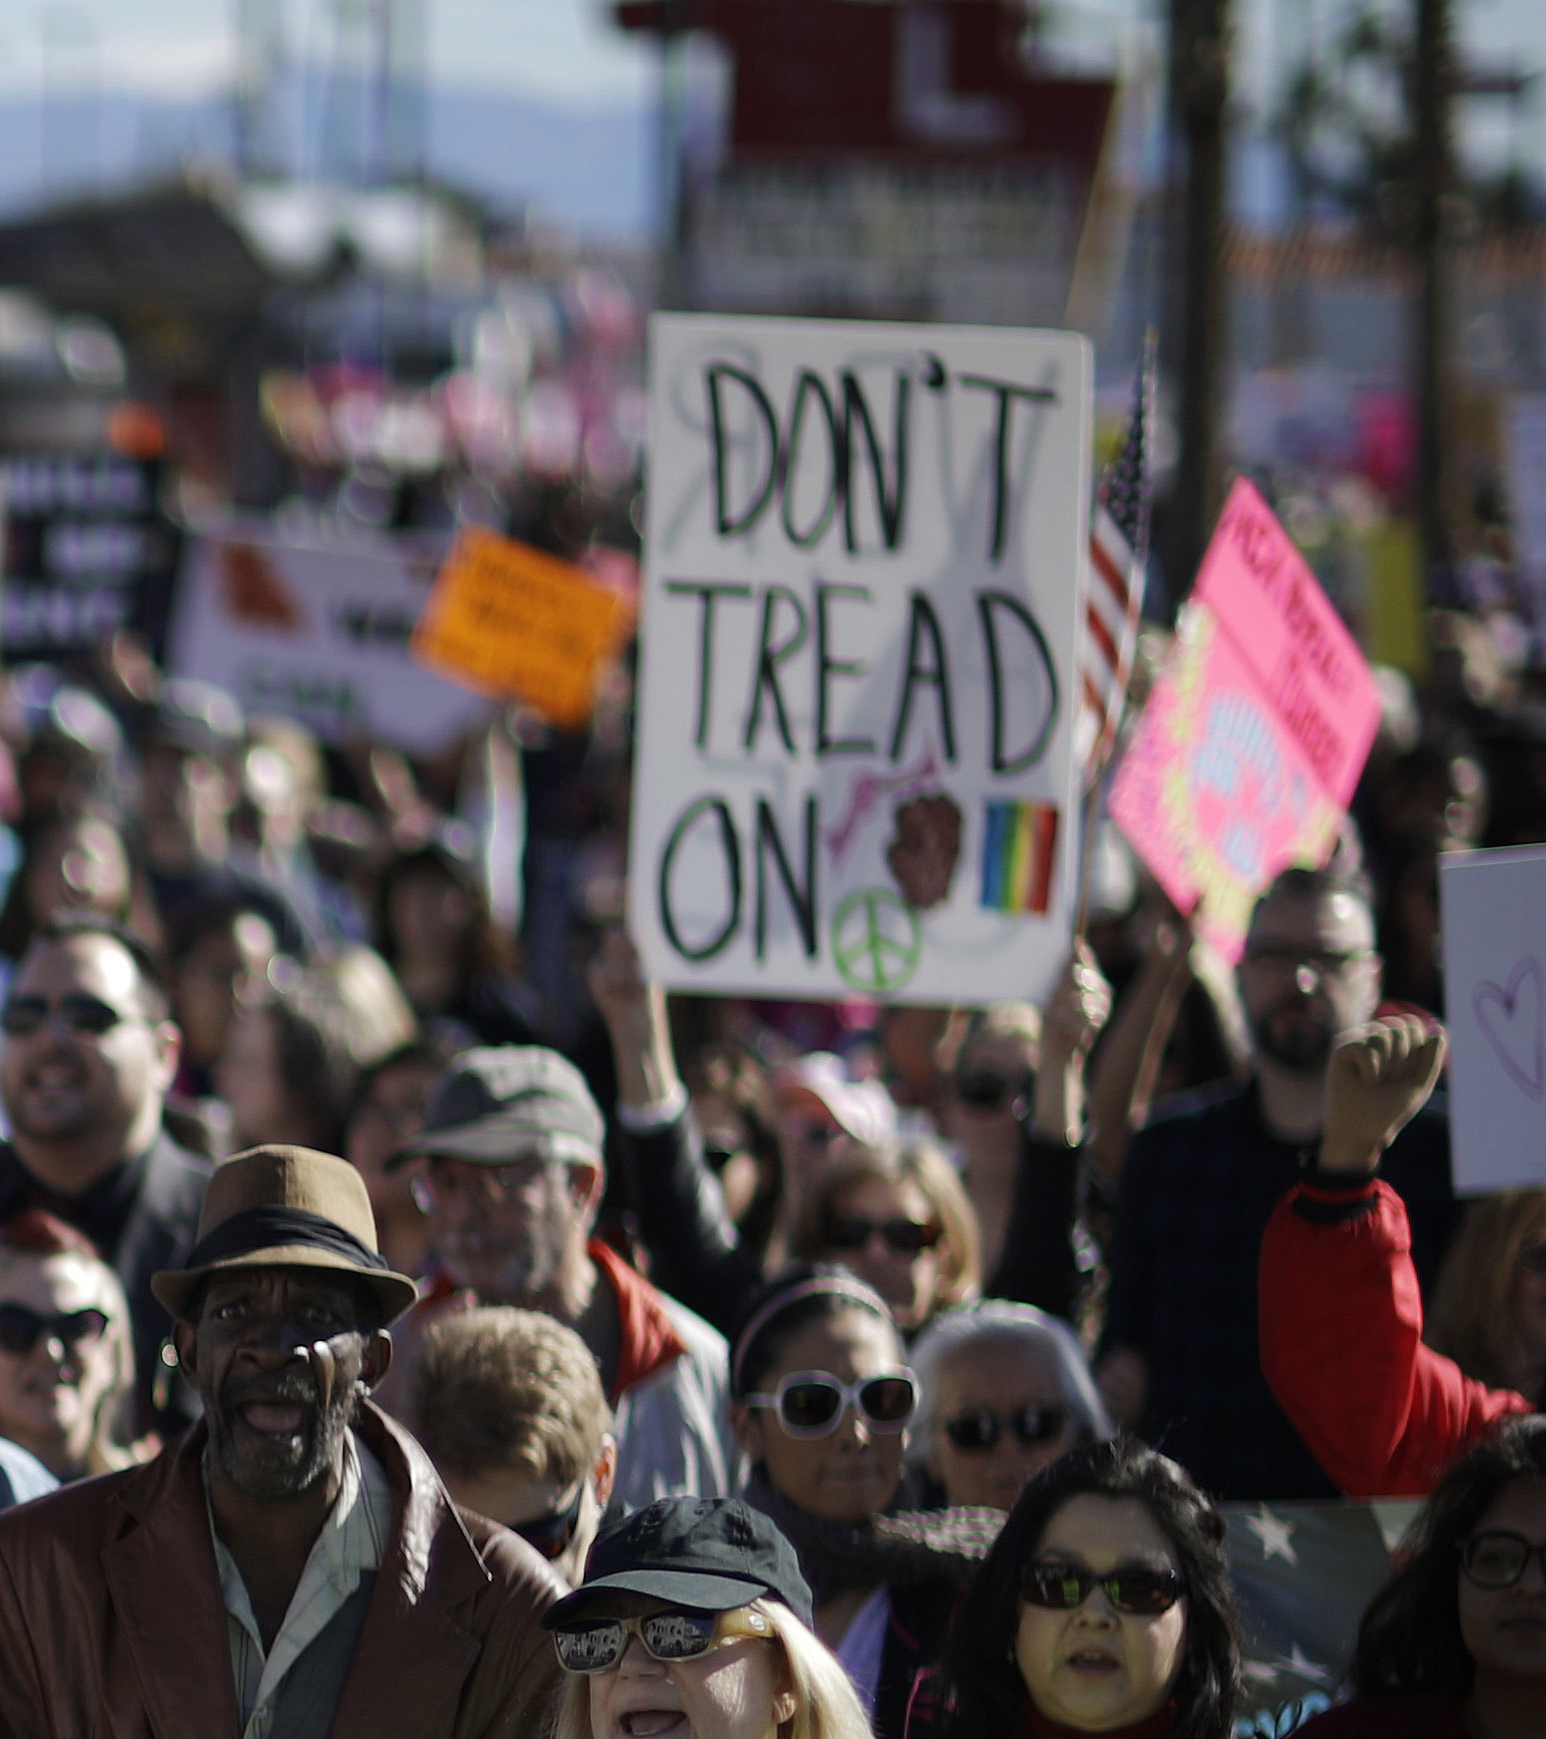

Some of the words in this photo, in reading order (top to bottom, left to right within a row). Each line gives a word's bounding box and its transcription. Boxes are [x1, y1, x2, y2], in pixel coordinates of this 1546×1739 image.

[701, 354, 1061, 566] DON'T
[661, 579, 1062, 776] TREAD
[659, 793, 820, 962] ON
